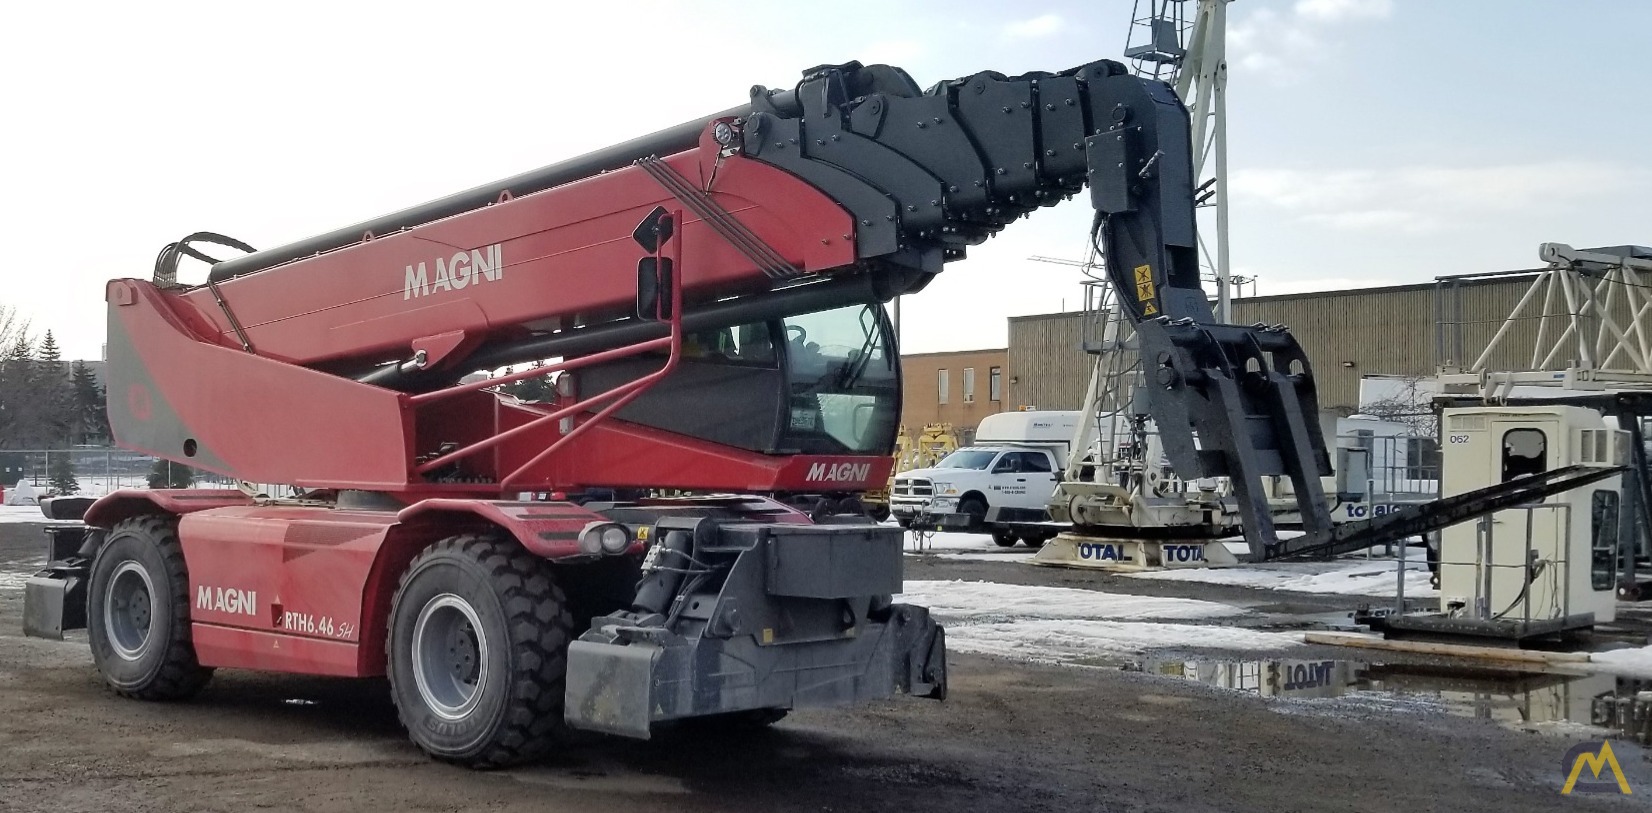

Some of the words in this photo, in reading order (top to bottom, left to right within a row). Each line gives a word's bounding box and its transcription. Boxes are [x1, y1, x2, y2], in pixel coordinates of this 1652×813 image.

[404, 243, 502, 300] MAGNI
[1450, 435, 1469, 444] 062
[805, 462, 870, 482] MAGNI
[1078, 542, 1133, 561] OTAL
[1163, 544, 1208, 562] TOTA
[196, 585, 257, 615] MAGNI
[285, 611, 334, 636] RTH6.46
